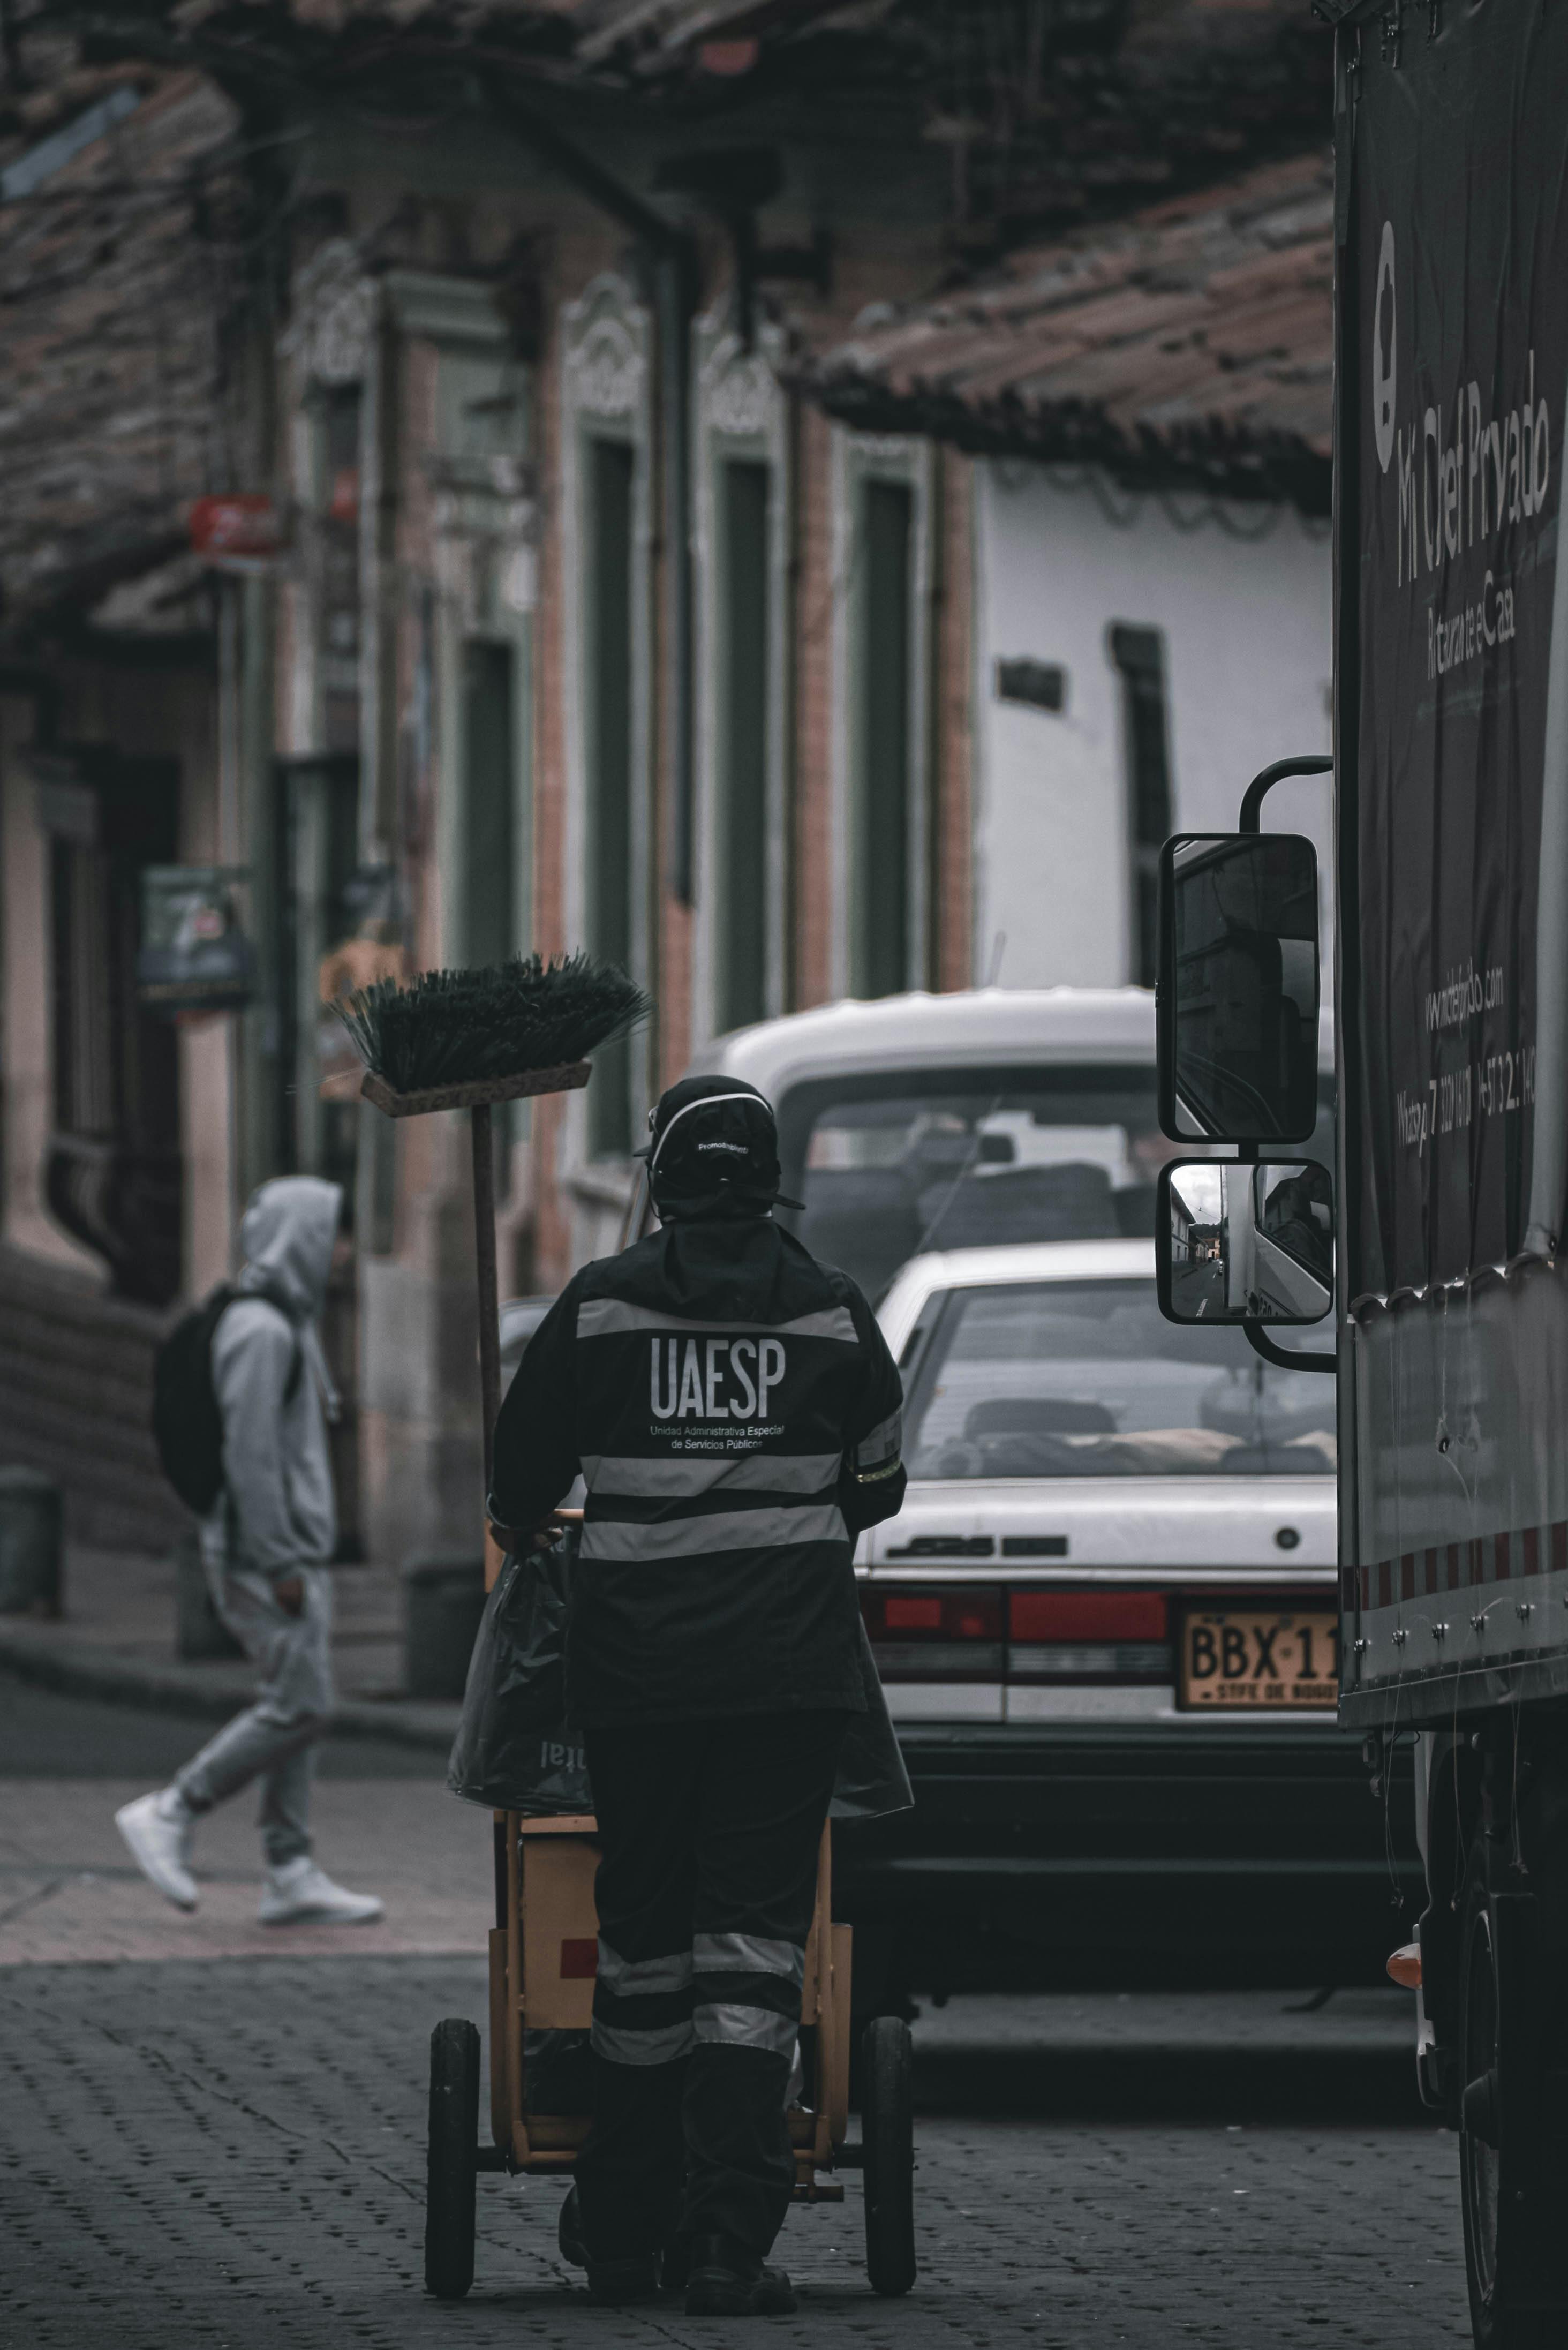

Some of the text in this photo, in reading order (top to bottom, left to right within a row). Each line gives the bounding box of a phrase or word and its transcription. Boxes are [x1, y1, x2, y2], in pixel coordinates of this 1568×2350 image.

[1398, 422, 1418, 588] Mi
[650, 1338, 786, 1419] UAESP
[650, 1424, 785, 1438] Unidad Administrativa Especial
[671, 1438, 763, 1450] de Servicios Públicos
